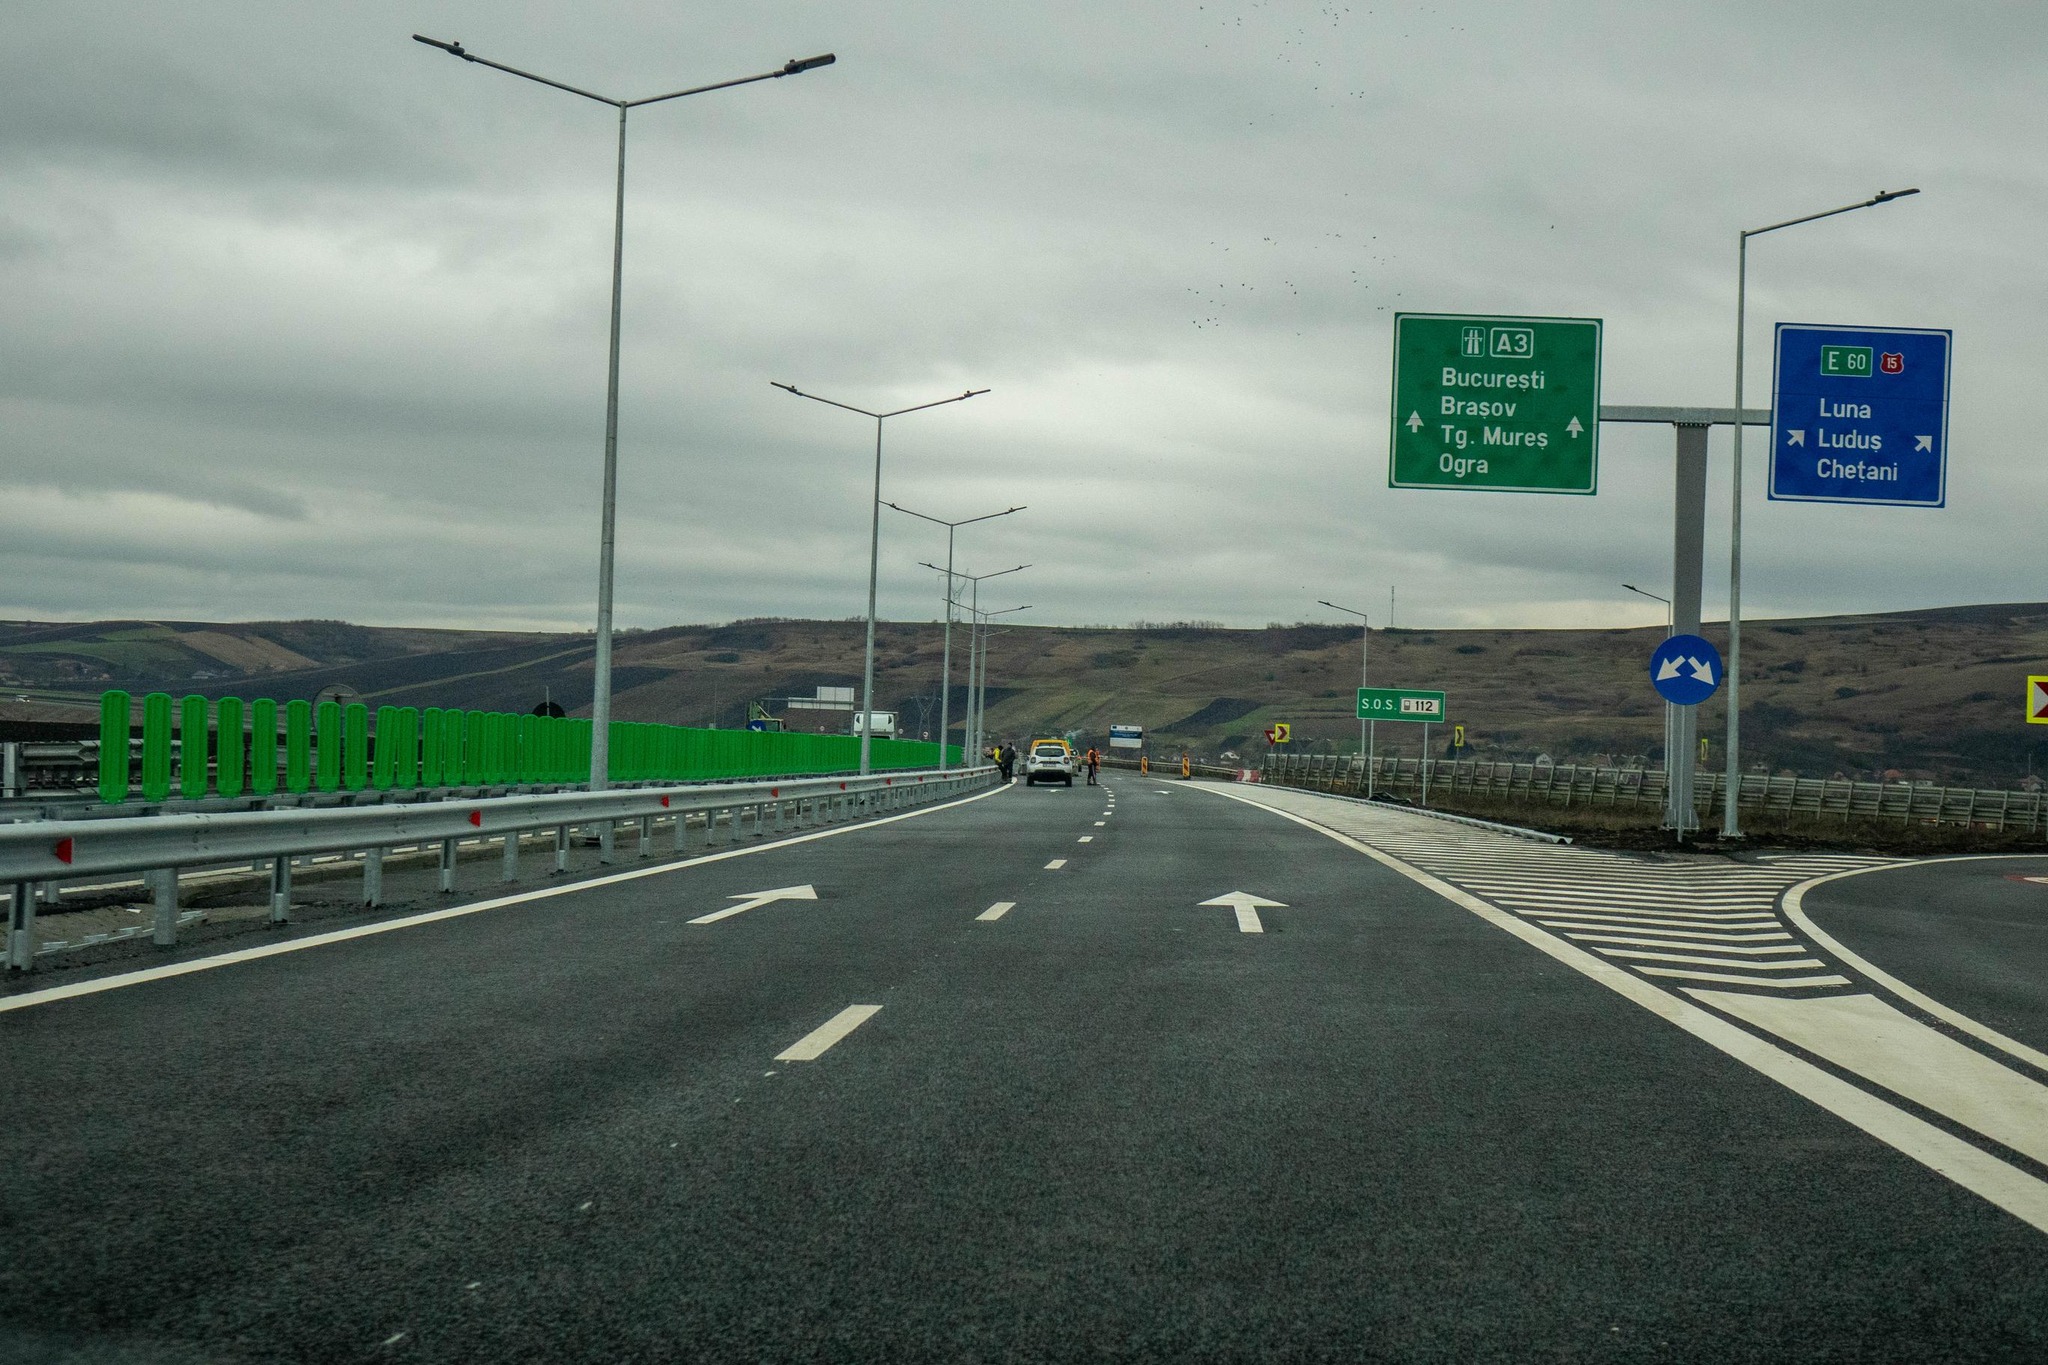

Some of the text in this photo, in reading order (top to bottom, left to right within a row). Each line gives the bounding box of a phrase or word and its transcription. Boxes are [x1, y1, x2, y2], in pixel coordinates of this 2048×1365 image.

[1496, 333, 1528, 353] A3
[1828, 351, 1866, 370] E 60
[1887, 357, 1898, 370] 15
[1442, 367, 1545, 391] București
[1441, 396, 1517, 419] Brașov
[1819, 398, 1872, 419] Luna
[1441, 425, 1548, 450] Tg. Mureș
[1818, 428, 1882, 453] Luduș
[1439, 453, 1489, 478] Ogra
[1817, 458, 1898, 482] Chețani
[1362, 699, 1397, 711] S.O.S.
[1415, 701, 1433, 712] 112
